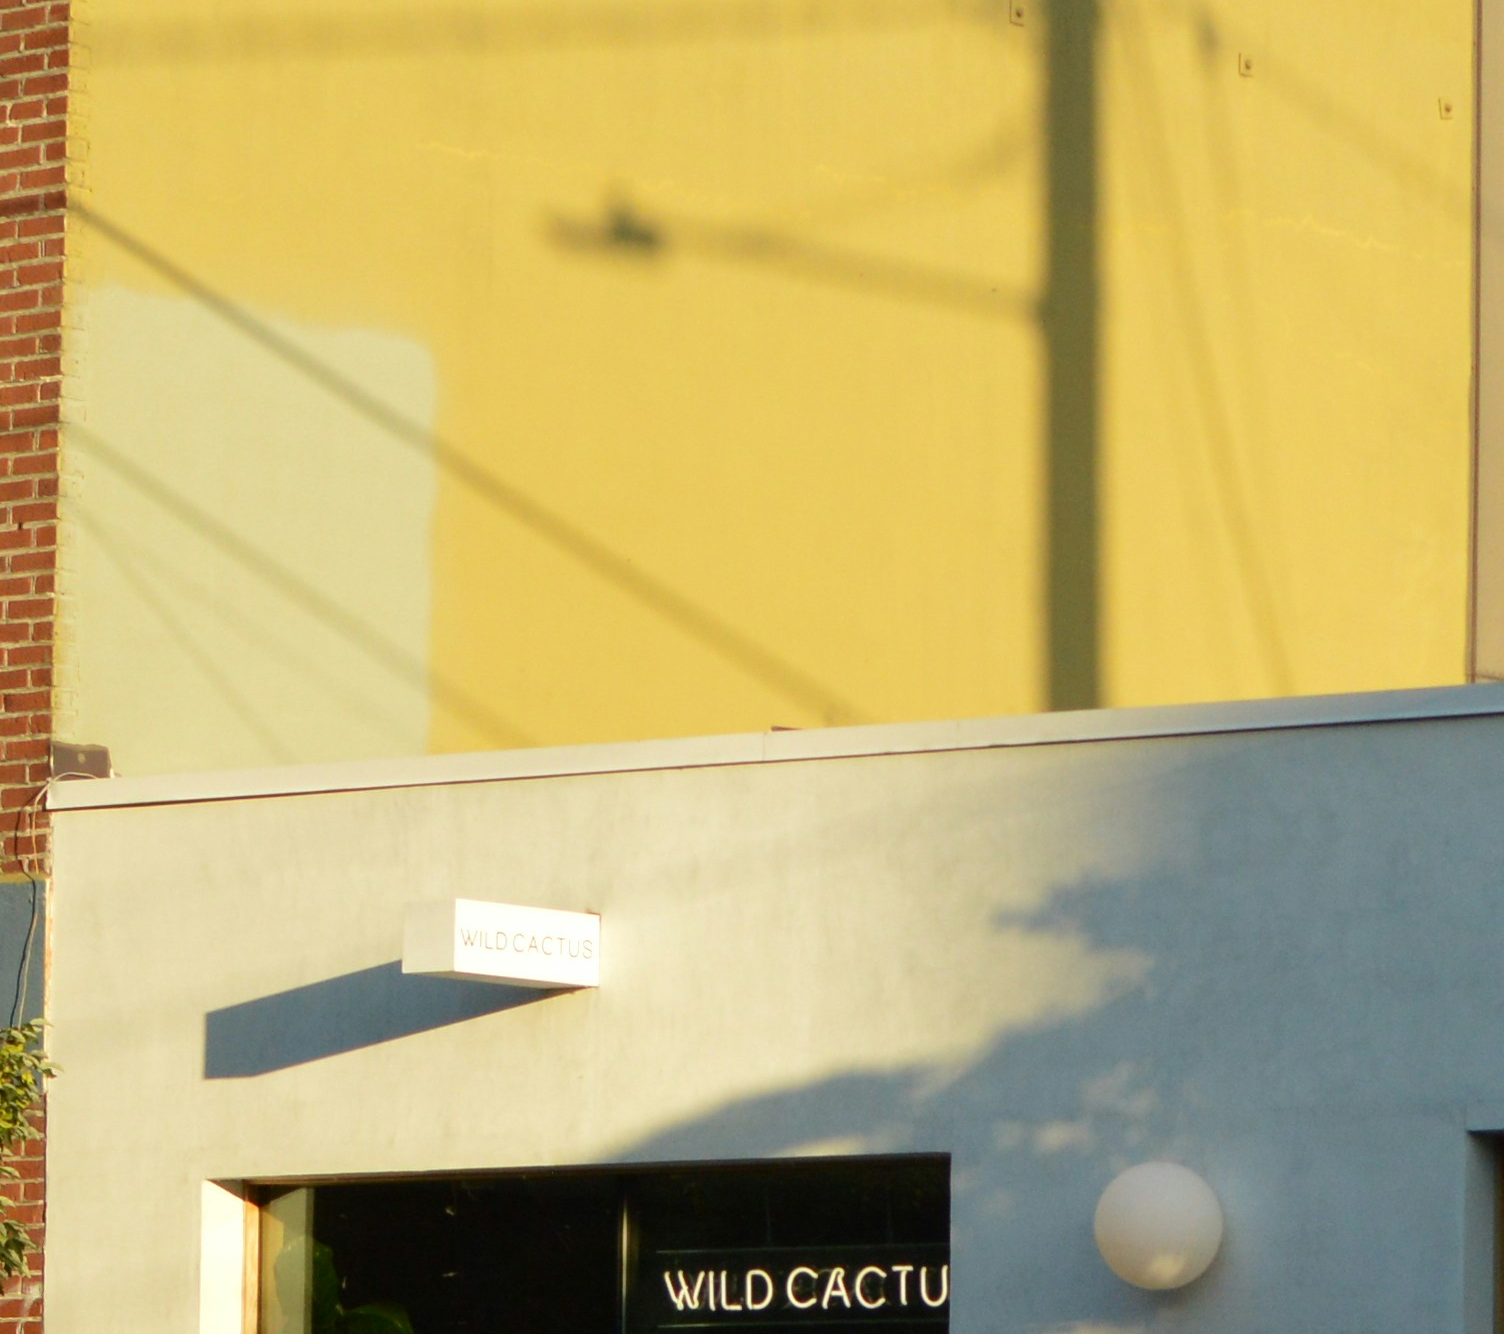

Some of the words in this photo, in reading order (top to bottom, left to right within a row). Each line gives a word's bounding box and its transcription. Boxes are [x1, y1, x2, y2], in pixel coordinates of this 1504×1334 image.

[461, 928, 507, 951] WILD
[512, 933, 593, 959] CACTUS
[663, 1267, 774, 1311] WILD
